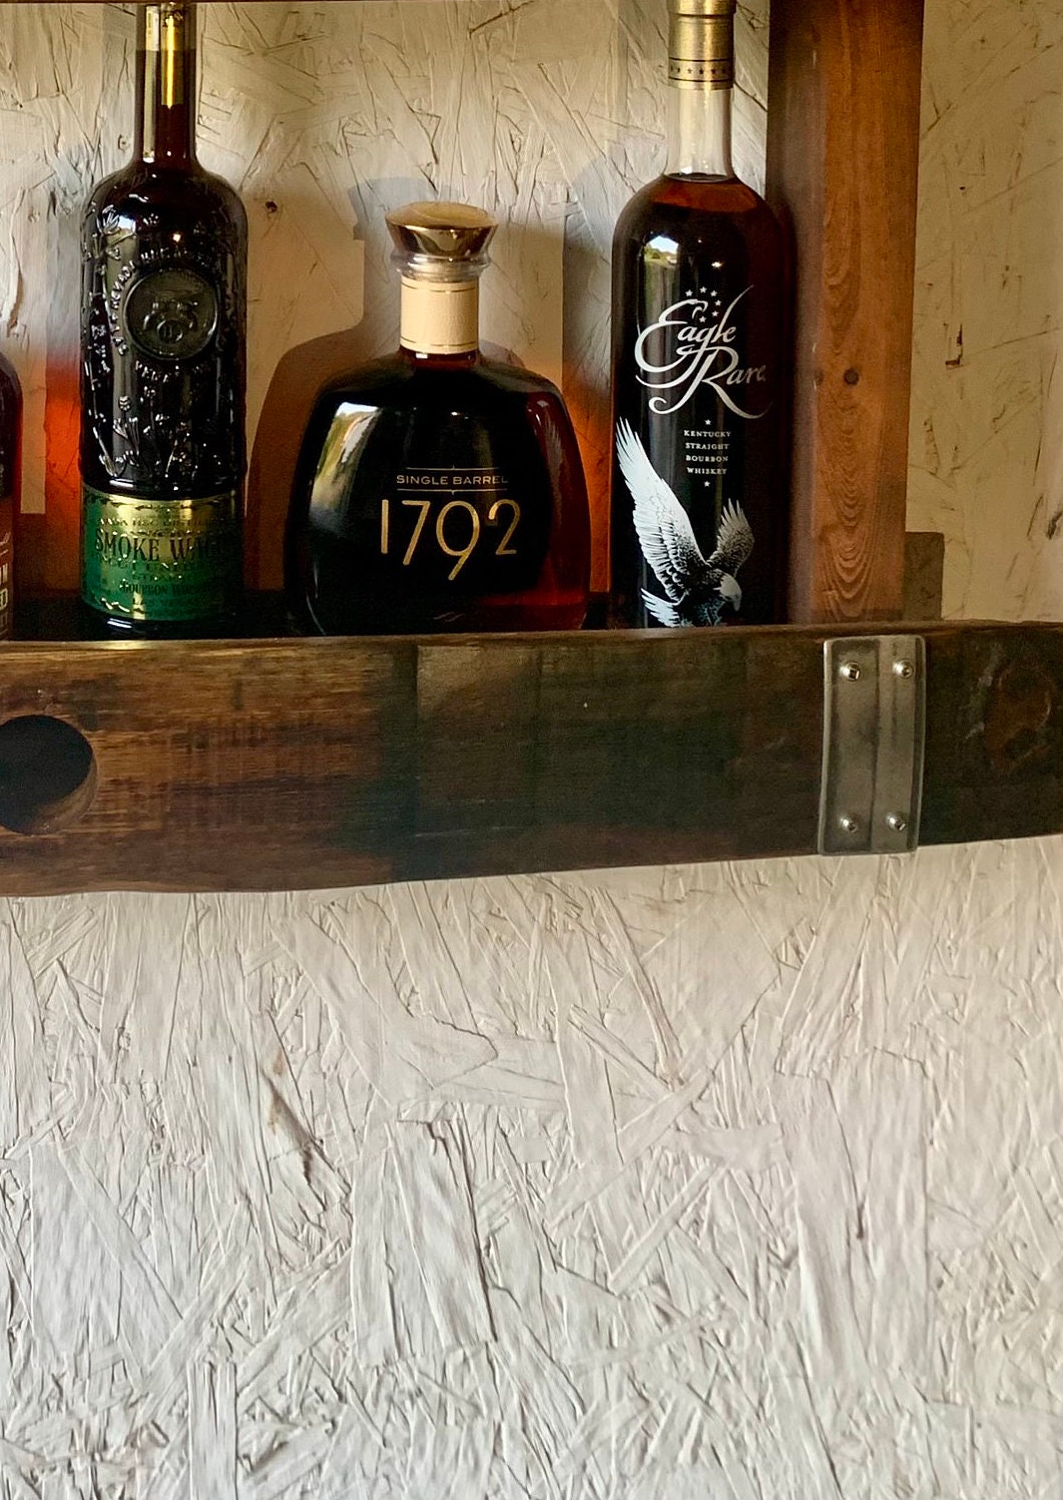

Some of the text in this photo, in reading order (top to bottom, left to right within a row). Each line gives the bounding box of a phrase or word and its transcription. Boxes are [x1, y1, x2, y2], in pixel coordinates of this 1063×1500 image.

[634, 284, 774, 419] Eagle Rare
[685, 442, 730, 450] STRAIGHT
[396, 475, 509, 485] SINGLE BARREL
[686, 467, 727, 475] WHISKEY
[95, 529, 160, 562] SMOKE
[381, 499, 521, 581] 1792
